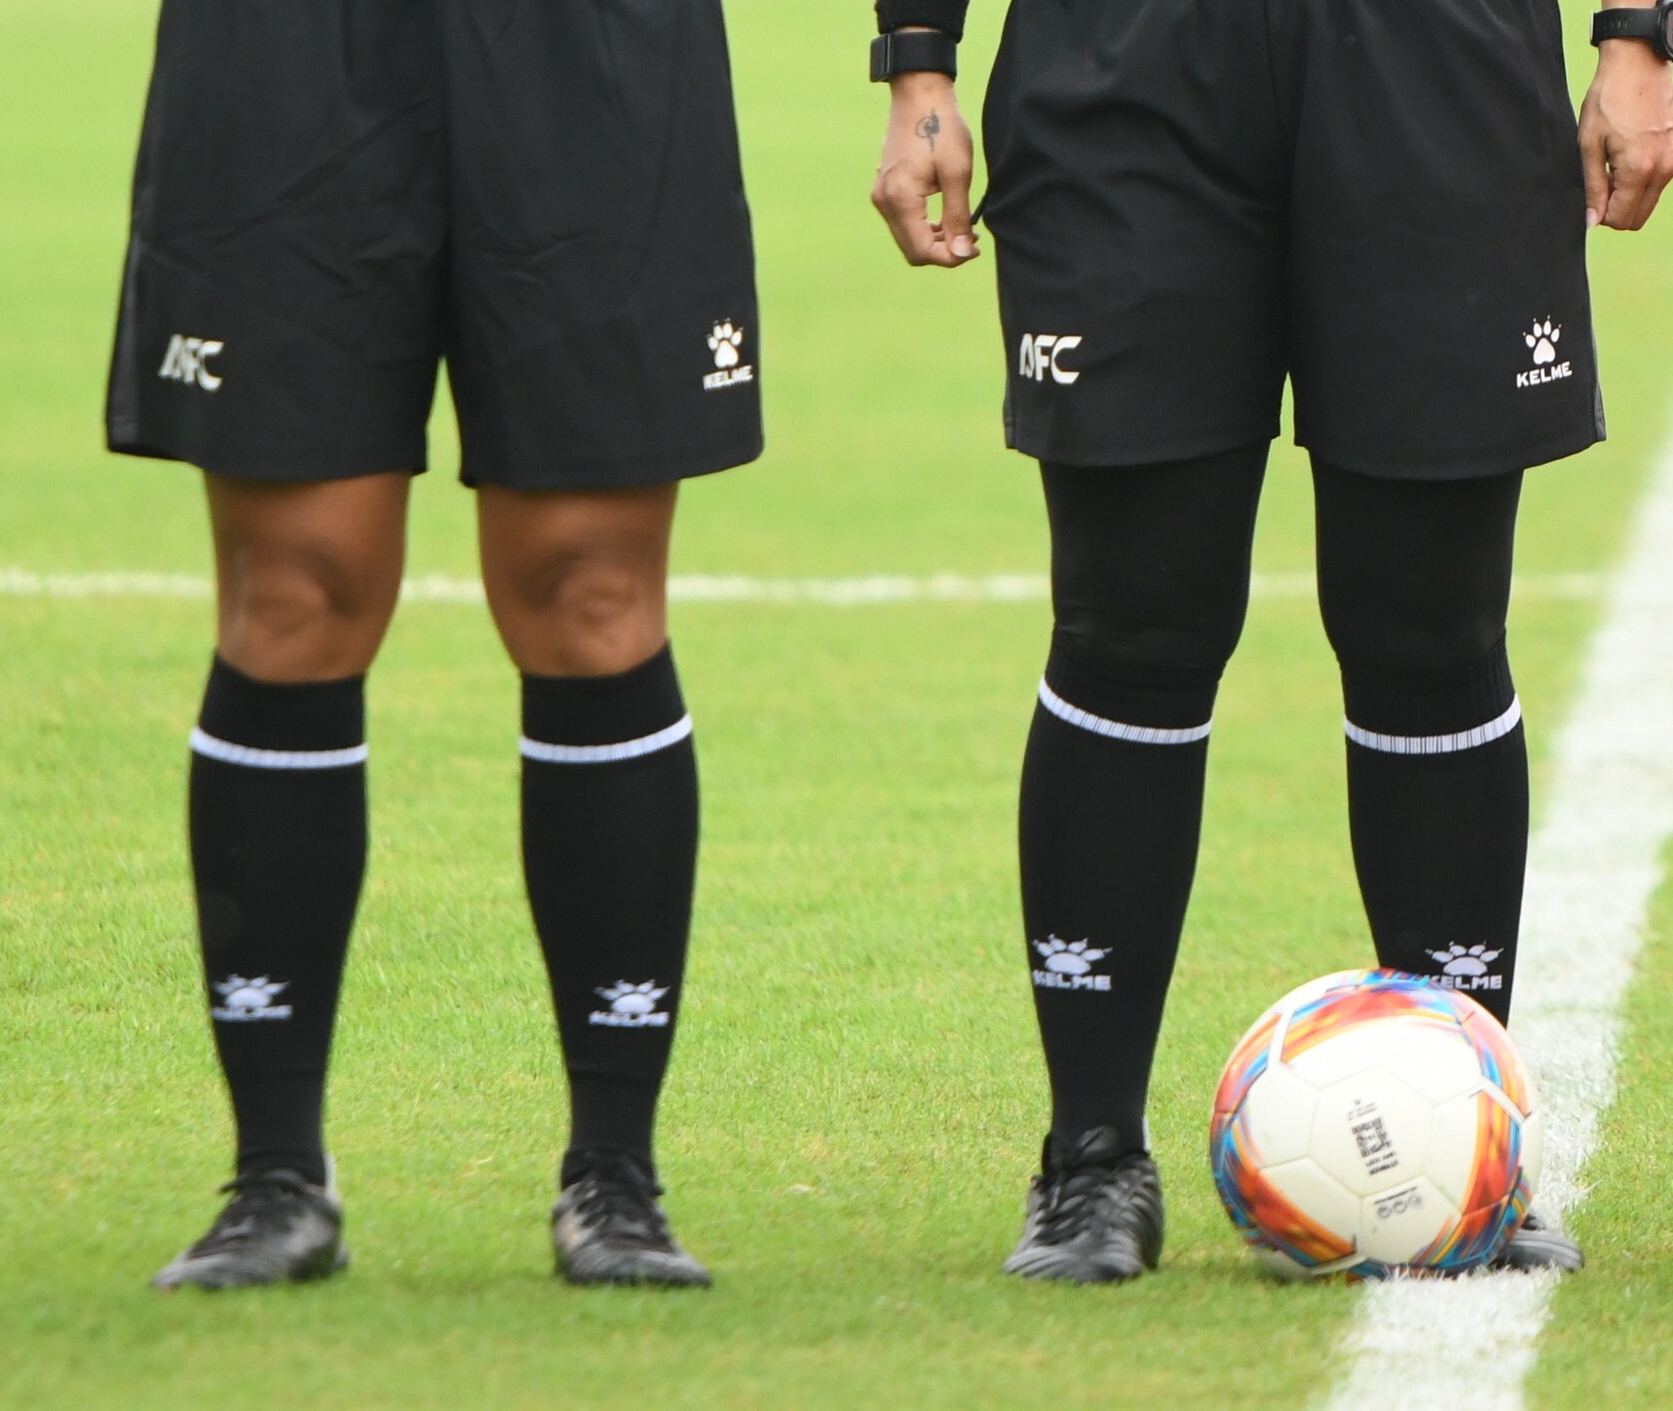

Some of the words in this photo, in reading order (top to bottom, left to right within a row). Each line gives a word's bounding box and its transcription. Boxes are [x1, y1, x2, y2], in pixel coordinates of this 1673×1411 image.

[157, 333, 225, 393] AFC
[1018, 332, 1083, 385] AFC
[1516, 361, 1573, 388] KELME
[1032, 969, 1112, 991] KELME
